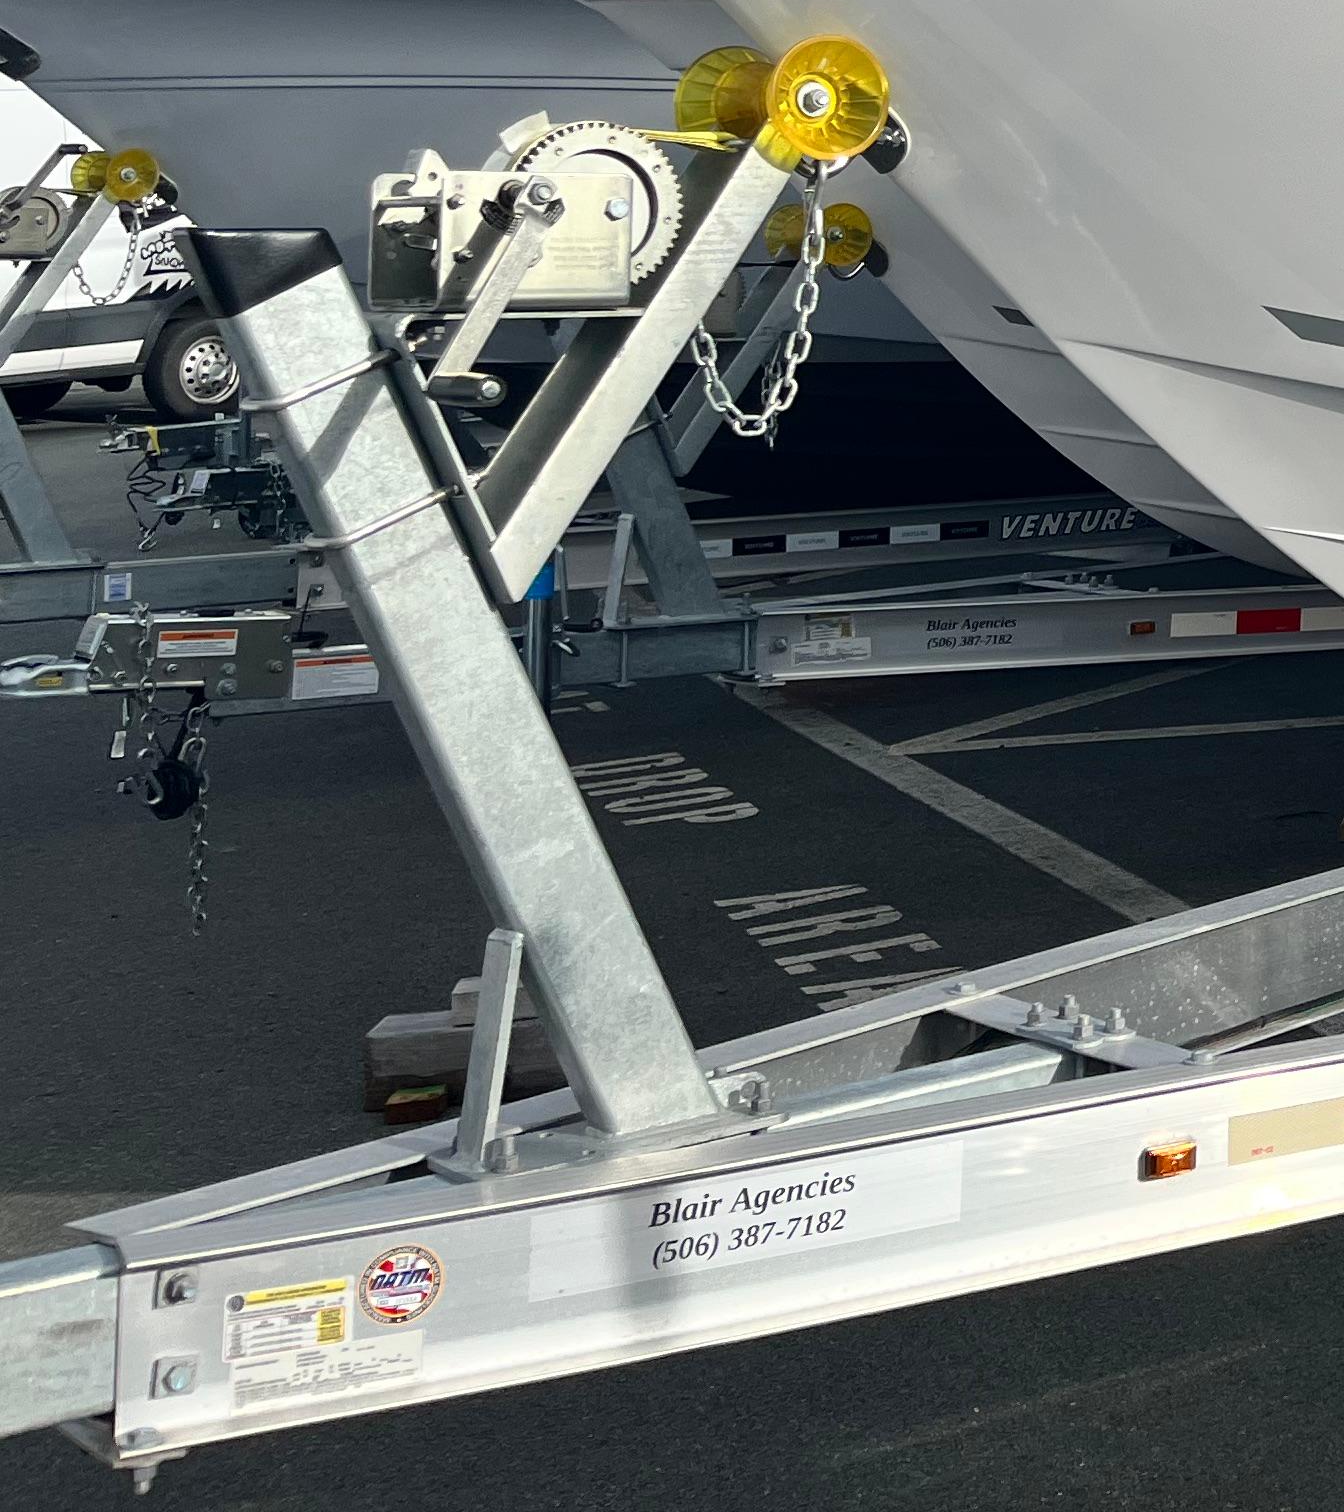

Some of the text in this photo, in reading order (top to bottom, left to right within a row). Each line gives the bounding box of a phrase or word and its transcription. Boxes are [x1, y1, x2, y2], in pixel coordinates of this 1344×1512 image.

[1000, 506, 1138, 539] VENTURE
[926, 616, 1017, 632] Blair Agencies
[926, 637, 957, 650] (506)
[648, 1171, 857, 1228] Blair Agencies
[652, 1208, 847, 1270] (506) 387-7182
